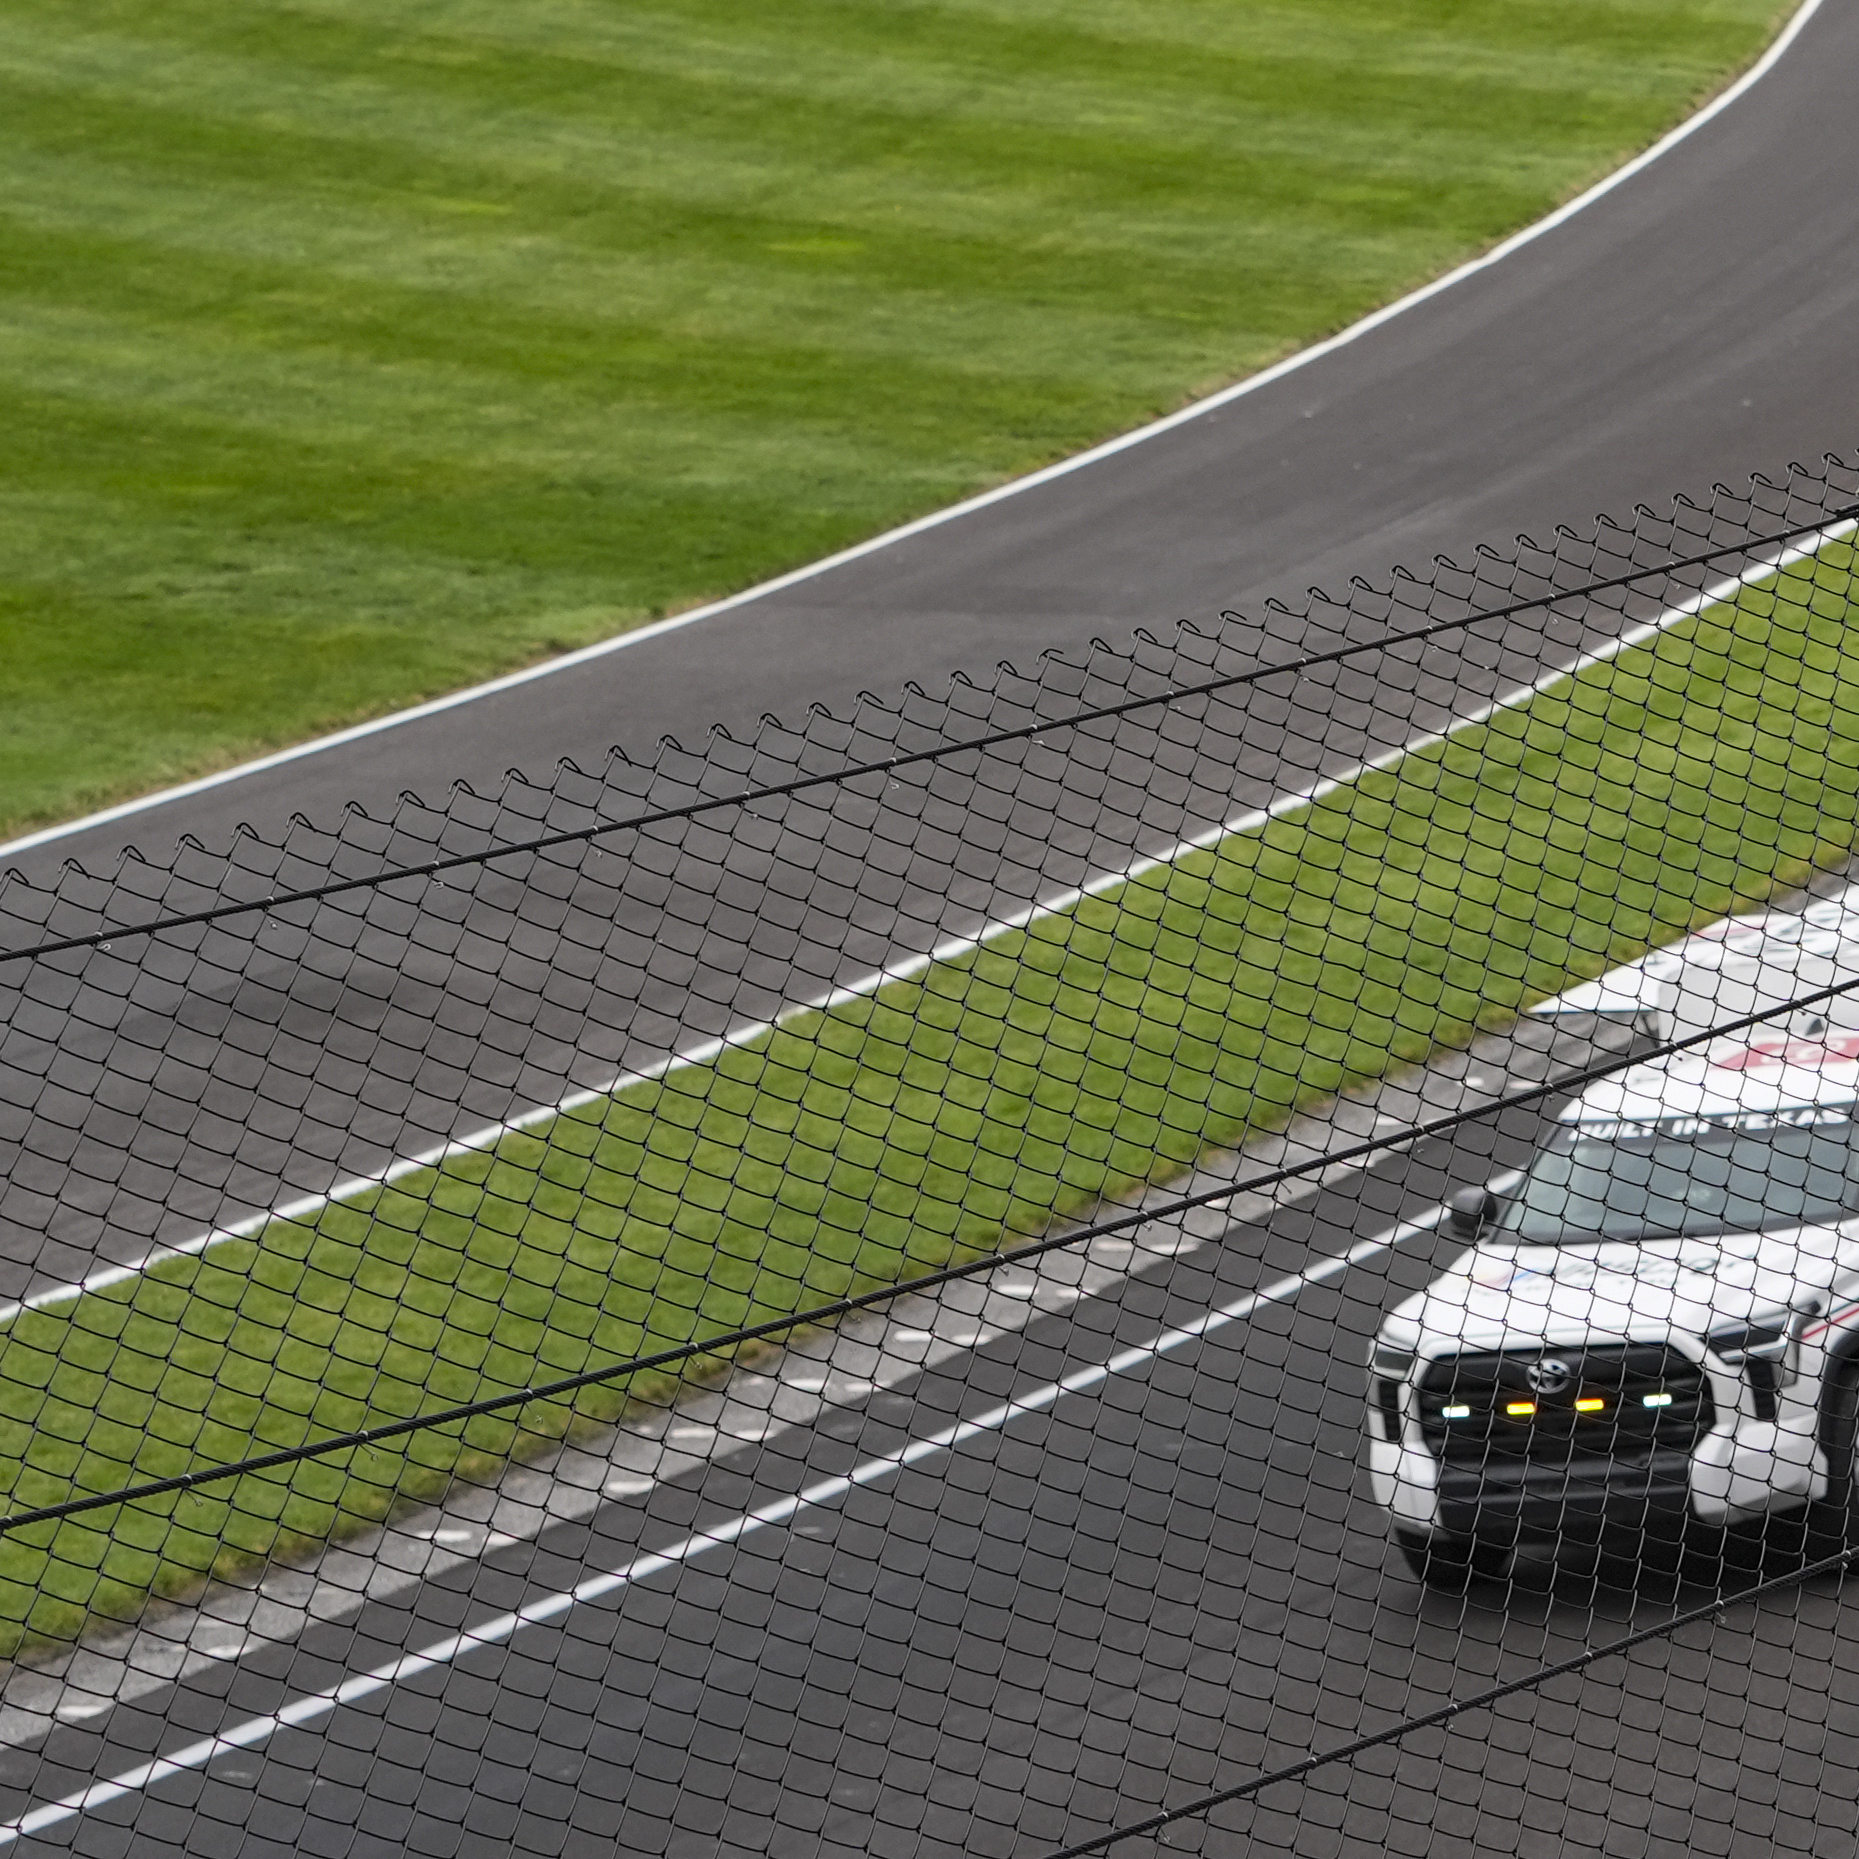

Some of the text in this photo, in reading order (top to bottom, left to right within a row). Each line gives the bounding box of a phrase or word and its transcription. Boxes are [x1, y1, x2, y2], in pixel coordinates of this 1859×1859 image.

[1568, 1107, 1849, 1142] BUILT IN TEXAS
